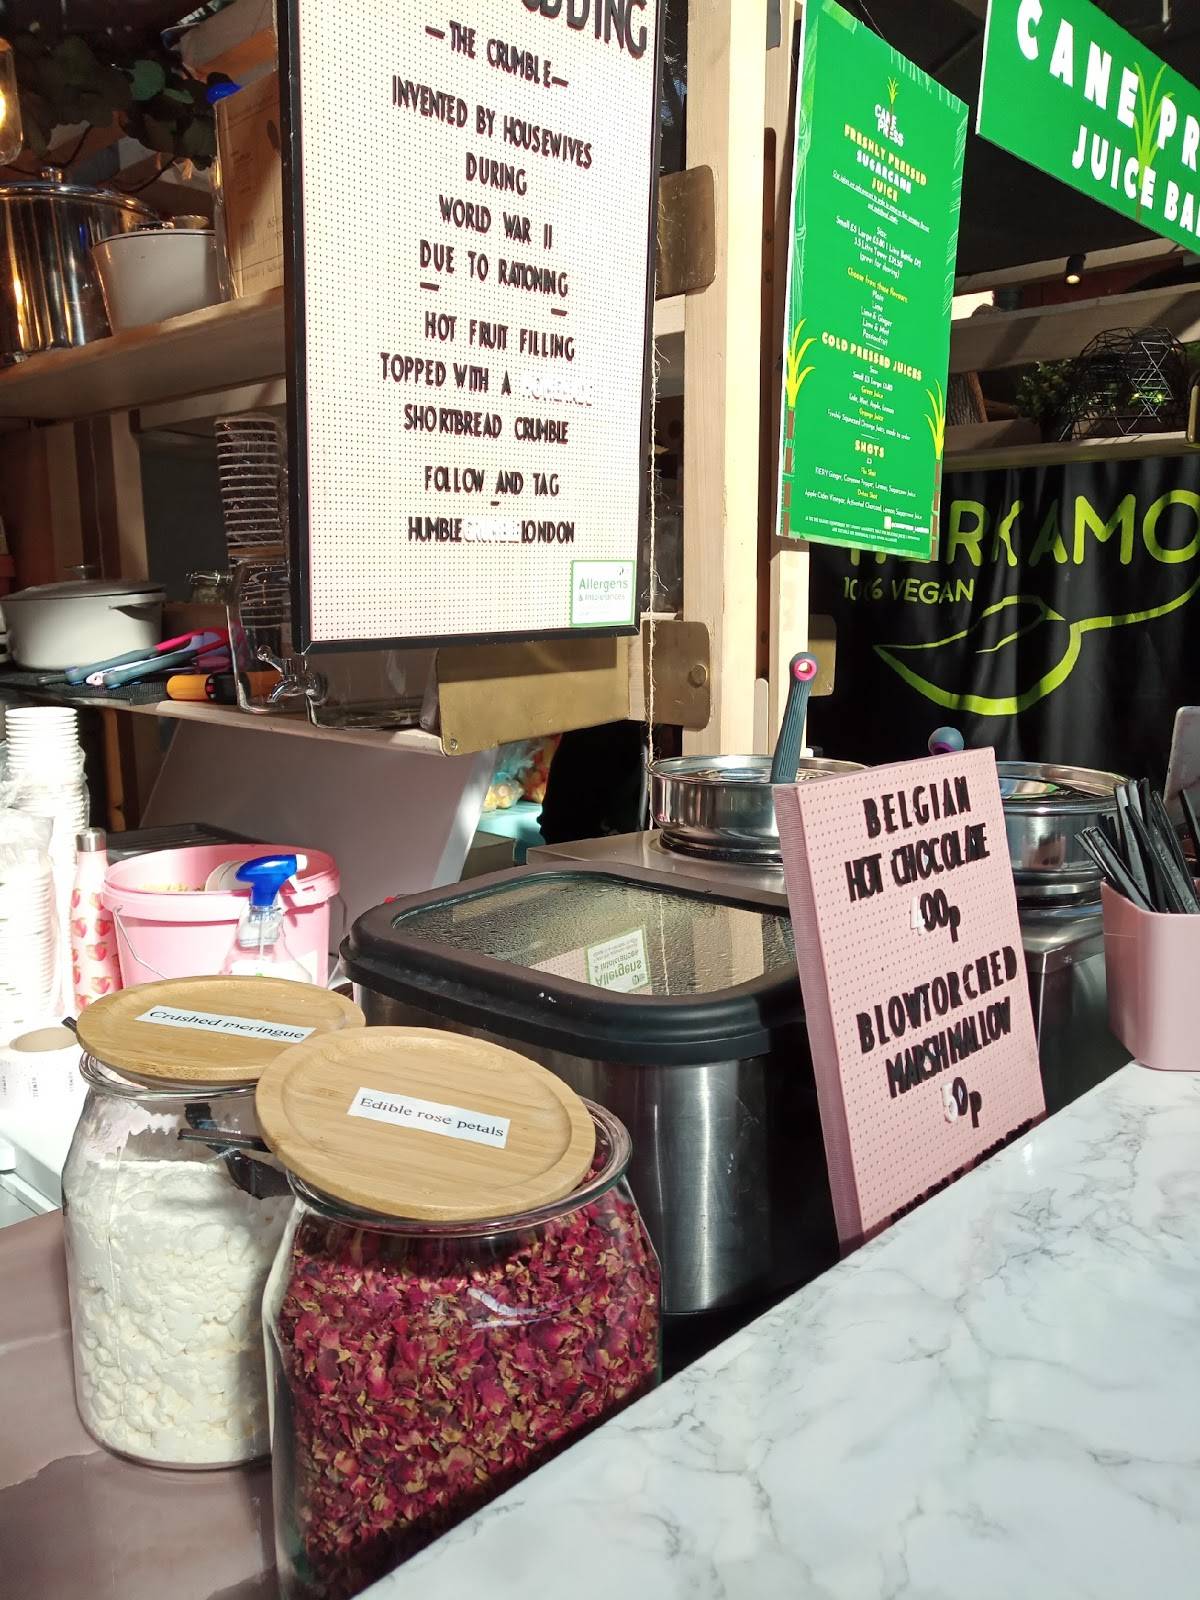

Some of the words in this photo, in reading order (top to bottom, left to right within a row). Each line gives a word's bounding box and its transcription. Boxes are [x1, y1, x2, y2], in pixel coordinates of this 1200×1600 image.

[523, 0, 648, 59] DING
[1017, 0, 1140, 128] CANE
[392, 75, 468, 127] INVENTED
[476, 105, 496, 137] BY
[504, 116, 592, 169] HOUSEWIVES
[466, 152, 527, 196] DURING
[844, 124, 886, 160] FRESHLY
[888, 152, 927, 186] PRESSED
[856, 150, 911, 194] SUGARCANE
[872, 177, 899, 202] JUICE
[1072, 125, 1157, 209] JUICE
[1164, 180, 1200, 238] BA
[439, 194, 491, 234] WORLD
[503, 211, 531, 245] WAR
[544, 223, 553, 249] II
[858, 227, 872, 242] Large
[420, 239, 455, 274] DUE
[468, 250, 489, 282] TO
[425, 311, 457, 342] HOT
[470, 319, 508, 351] FRUIT
[520, 328, 575, 361] FILLING
[822, 332, 848, 352] COLD
[850, 343, 891, 368] PRESSED
[893, 361, 922, 381] JUICES
[380, 352, 446, 387] TOPPED
[453, 362, 489, 395] WITH
[501, 370, 511, 396] A
[404, 404, 502, 439] SHORTBREAD
[514, 416, 569, 444] CRUMBLE
[855, 440, 884, 458] SHOTS
[425, 466, 485, 493] FOLLOW
[496, 470, 524, 495] AND
[533, 472, 559, 497] TAG
[578, 577, 629, 592] Allergens
[891, 578, 975, 604] VEGAN
[862, 776, 971, 839] BELGIAN
[845, 854, 884, 902] HOT
[891, 822, 991, 883] CHOCOLATE
[856, 945, 1018, 1054] BLOWTORCHED
[149, 1010, 222, 1027] Crushed
[223, 1021, 305, 1038] meringue
[885, 996, 1012, 1098] MARSHMALLOW
[359, 1096, 413, 1117] Edible
[417, 1111, 452, 1126] rose
[456, 1119, 504, 1138] petals
[941, 1076, 982, 1129] 50p
